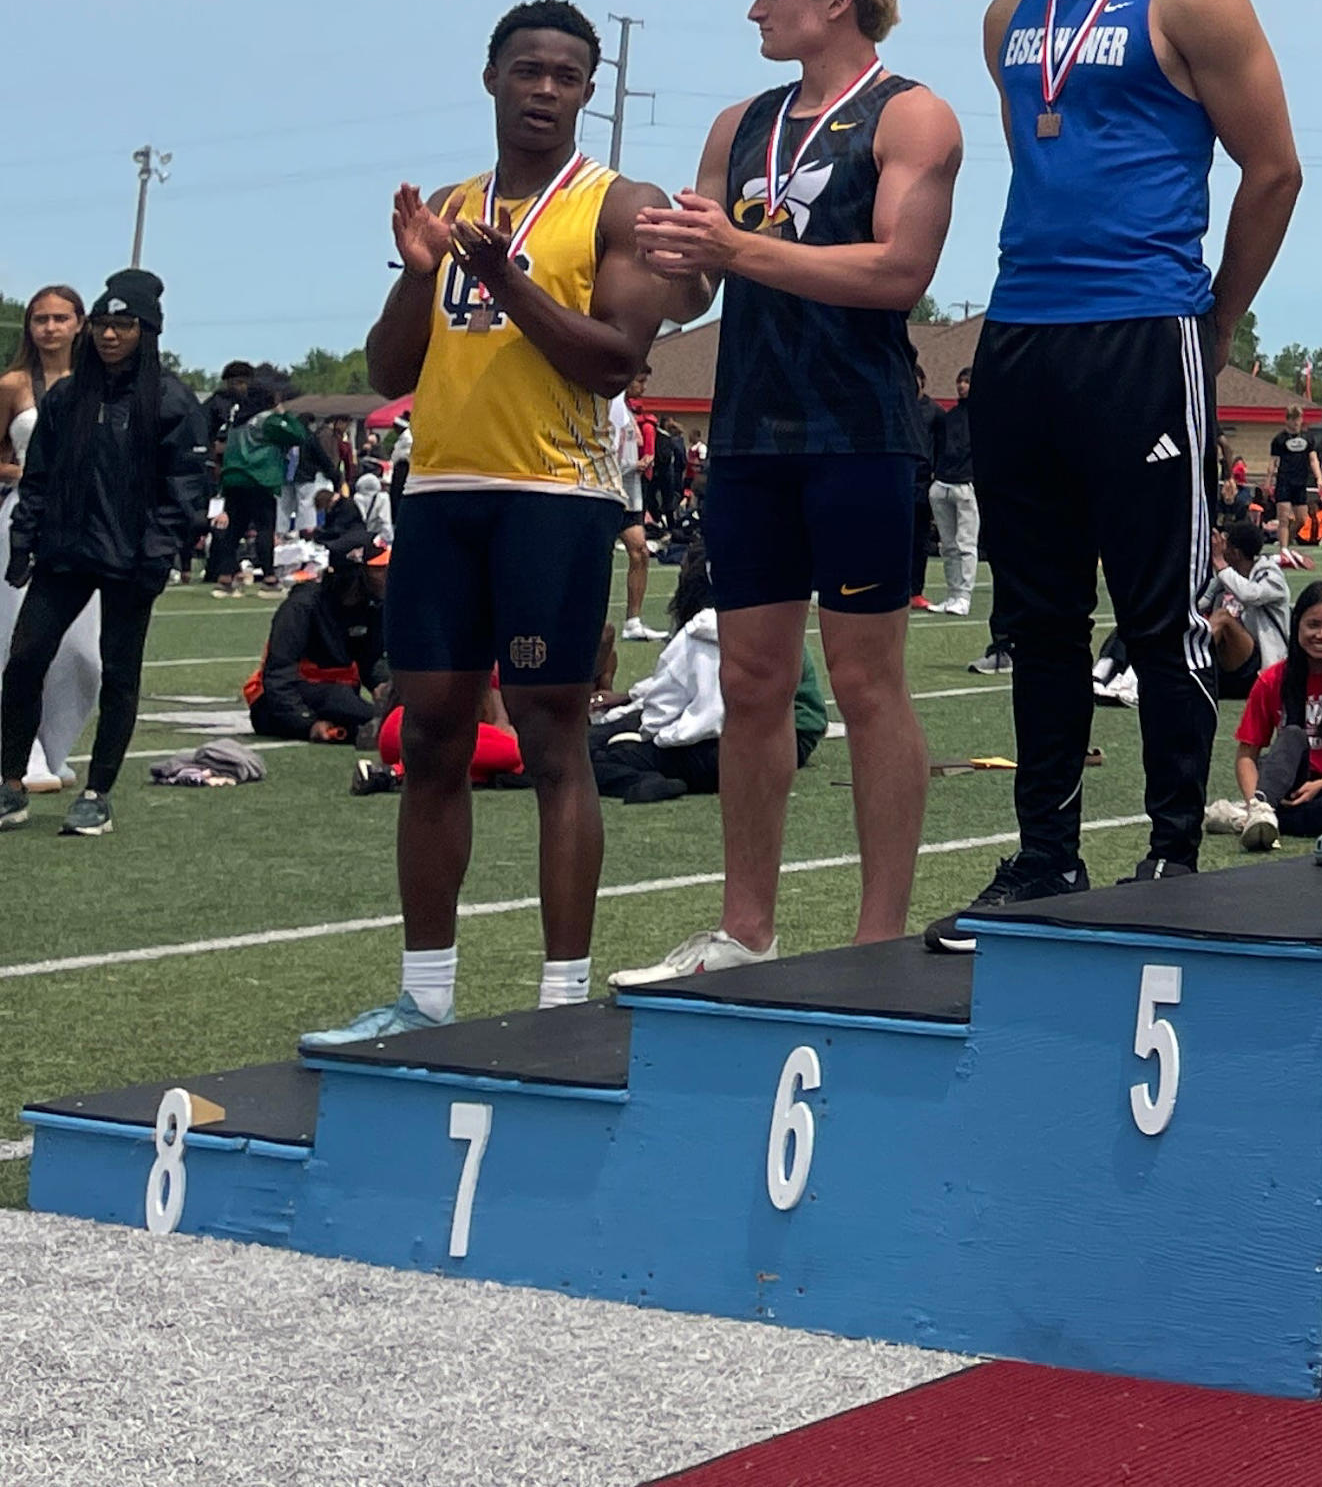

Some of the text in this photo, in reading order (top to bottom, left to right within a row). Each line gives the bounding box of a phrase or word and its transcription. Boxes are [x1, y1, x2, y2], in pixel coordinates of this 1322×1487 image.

[766, 1046, 821, 1211] 6
[1130, 964, 1182, 1136] 5
[146, 1088, 192, 1234] 8
[449, 1102, 493, 1258] 7
